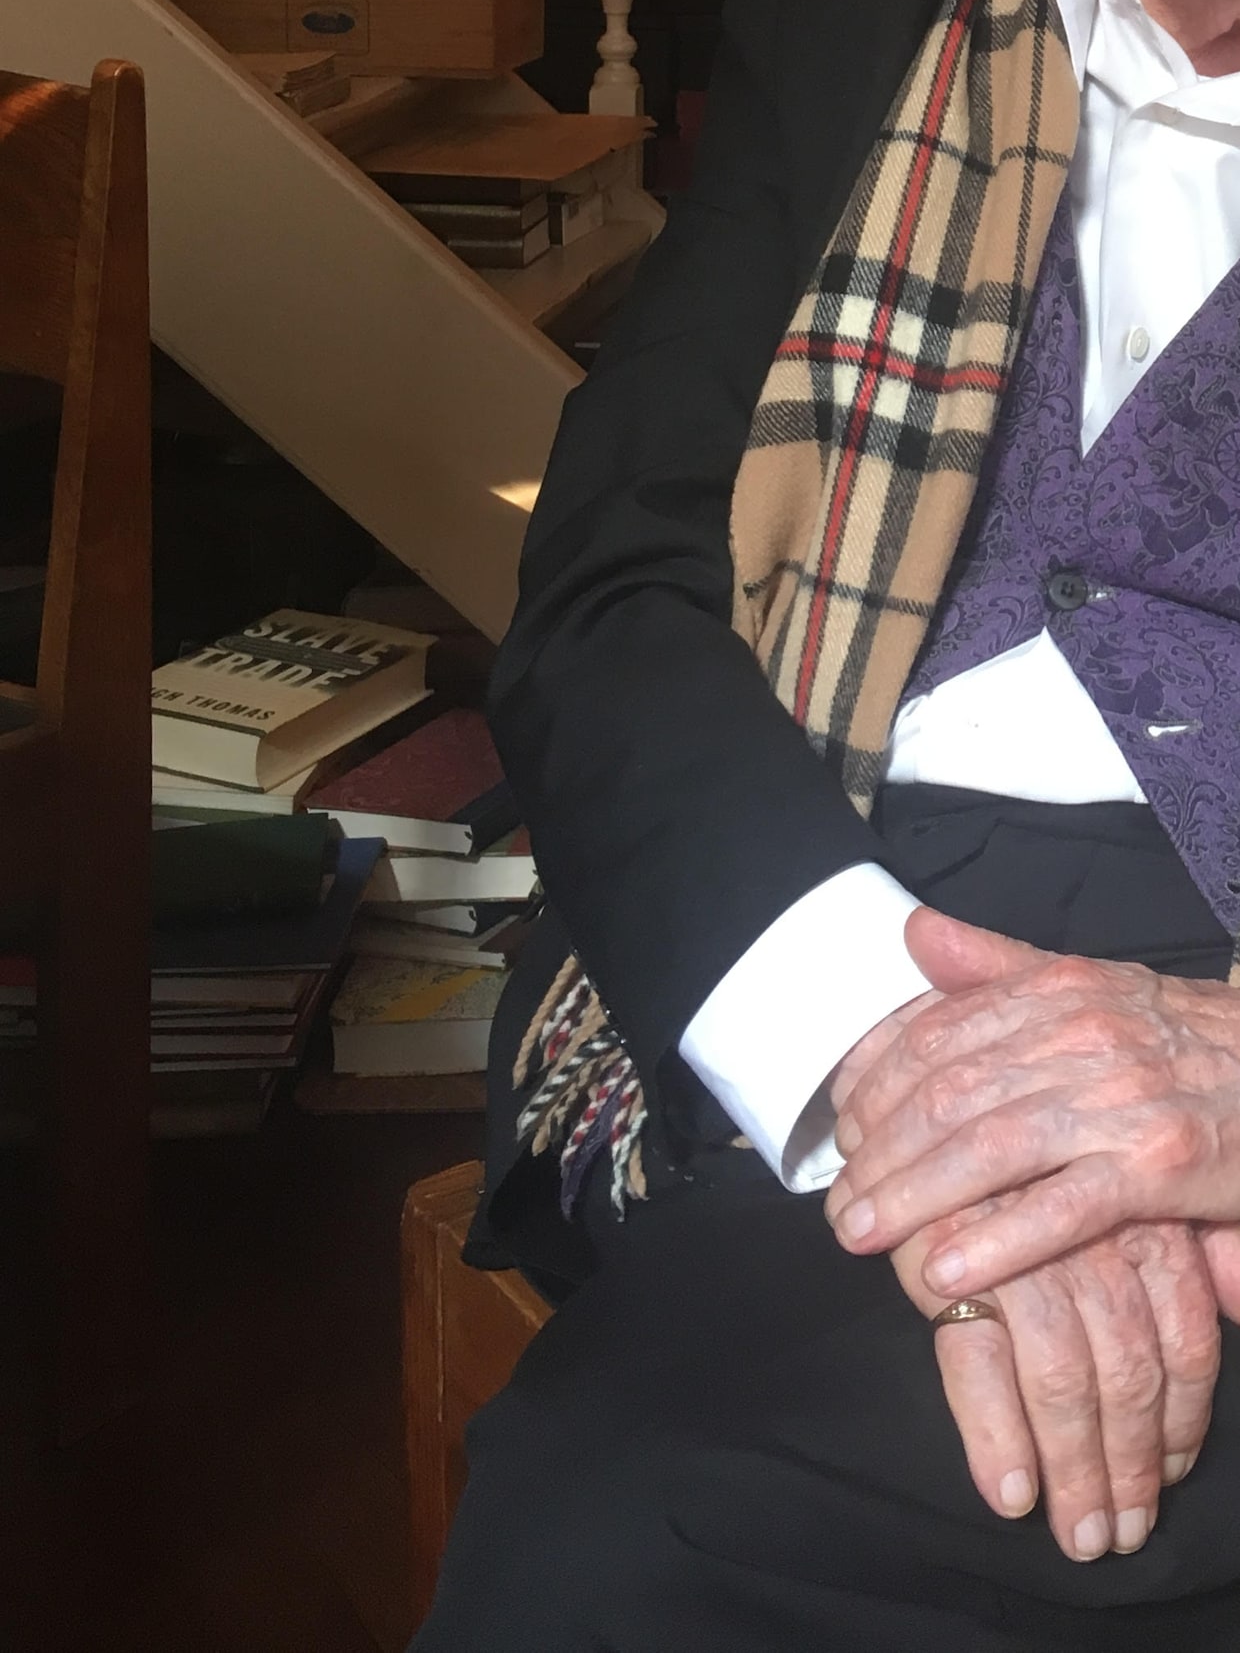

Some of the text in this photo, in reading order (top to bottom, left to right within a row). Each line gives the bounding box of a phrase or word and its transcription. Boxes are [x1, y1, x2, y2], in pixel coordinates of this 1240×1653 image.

[243, 622, 390, 665] SLAVE
[188, 648, 362, 688] TRADE
[186, 695, 276, 721] THOMAS
